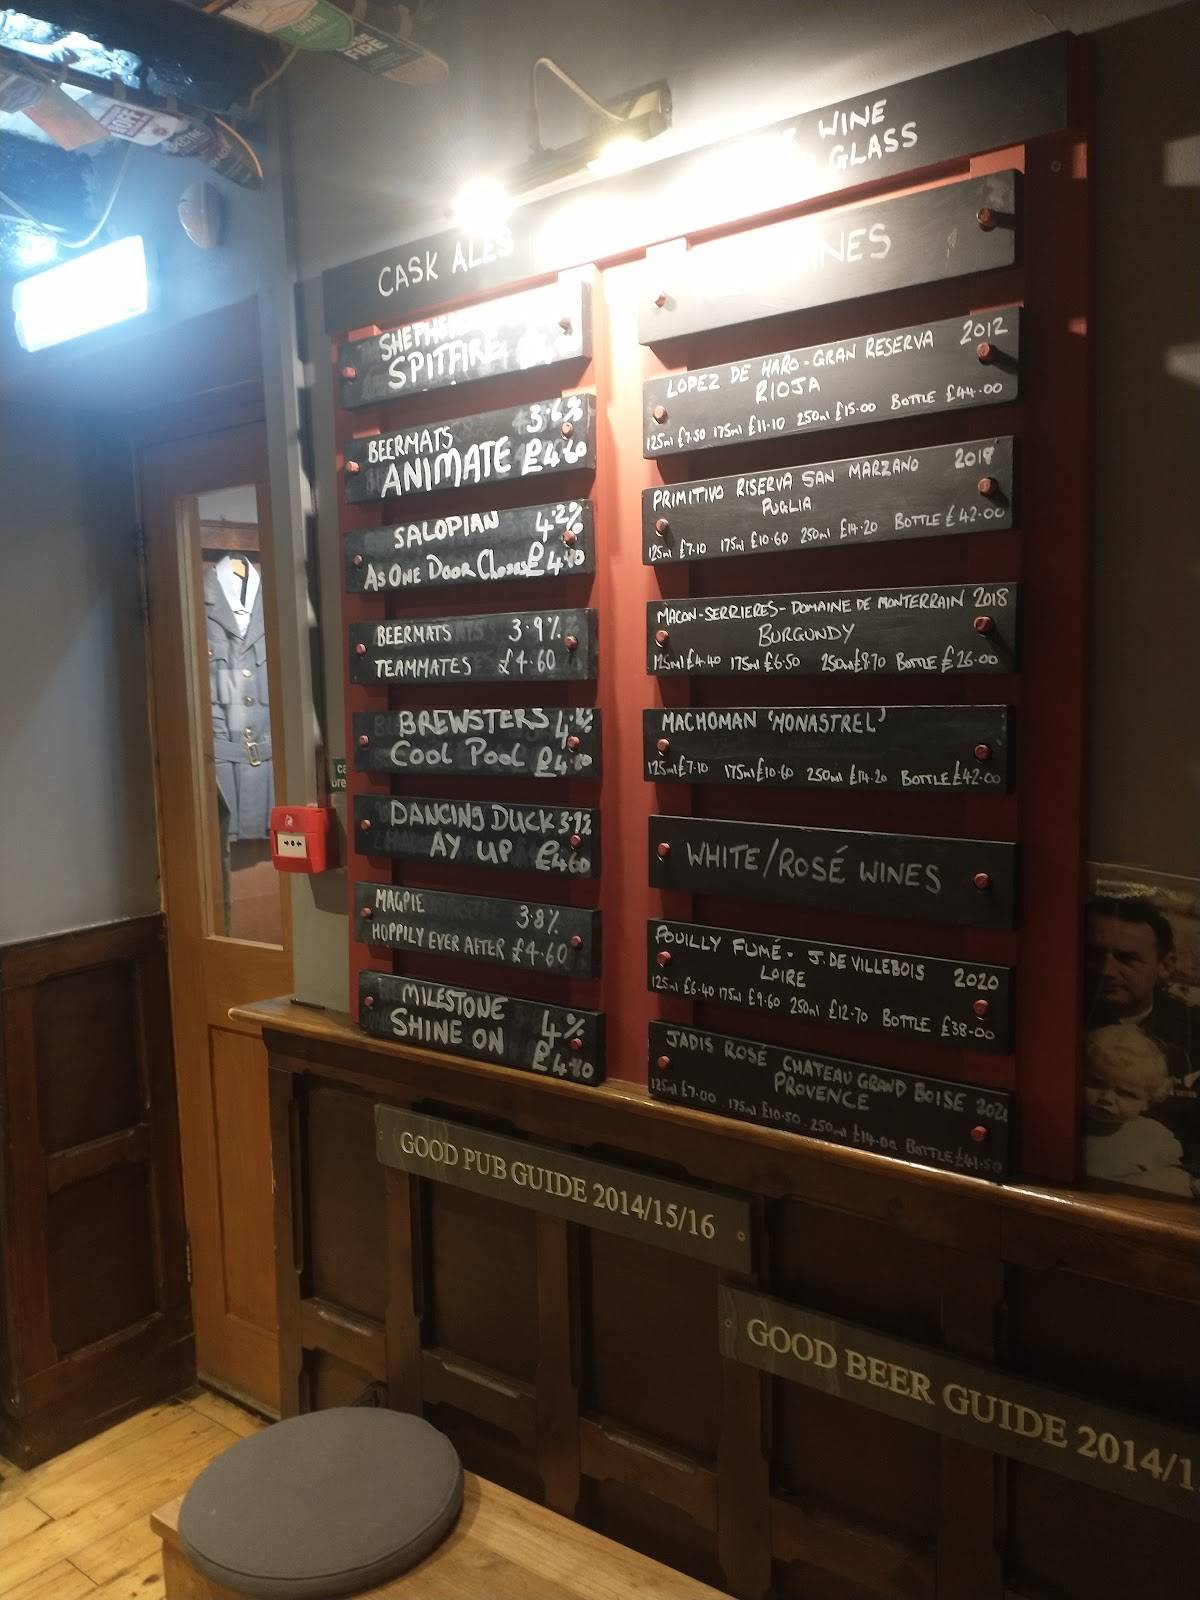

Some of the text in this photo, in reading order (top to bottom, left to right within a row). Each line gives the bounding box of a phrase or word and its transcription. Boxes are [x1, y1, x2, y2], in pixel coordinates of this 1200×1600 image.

[819, 100, 888, 138] WINE
[829, 121, 918, 168] GLASS
[378, 226, 514, 297] CASK ALES
[388, 333, 505, 389] SPITFIRE
[666, 374, 720, 398] LOPEZ
[730, 364, 752, 384] DE
[865, 330, 934, 358] RESERVA
[960, 317, 1008, 345] 2012
[755, 376, 821, 404] RIOJA
[677, 426, 706, 448] £7.50
[749, 415, 785, 436] £11.10
[835, 401, 876, 421] £15.00
[946, 383, 1003, 402] £44.00
[368, 426, 453, 463] BEERMATS
[381, 436, 512, 498] ANIMATE
[653, 485, 724, 511] PRIMITIVO
[736, 472, 793, 497] RISERVA
[802, 469, 835, 487] SAN
[849, 456, 919, 480] MARZANO
[762, 497, 812, 516] PUGLIA
[394, 511, 500, 549] SALOPIAN
[680, 538, 707, 559] £7.10
[751, 531, 789, 549] £10.60
[840, 518, 878, 539] £14.20
[946, 505, 1005, 527] £42.00
[791, 599, 851, 614] DOMAINE
[857, 597, 872, 610] DE
[878, 590, 965, 609] MONTERRAIN
[973, 587, 1009, 608] 2018
[377, 616, 562, 647] BEERMATS 3.9%
[759, 623, 855, 647] BURGUNDY
[375, 648, 555, 678] TEAMMATES £4.60
[687, 649, 721, 670] £4.40
[764, 651, 800, 672] £6.50
[941, 645, 998, 673] £26.00
[399, 708, 549, 737] BREWSTERS
[662, 710, 757, 733] MACHOMAN
[678, 755, 708, 777] £7.10
[757, 758, 793, 782] £10.60
[850, 764, 887, 785] £14.20
[491, 803, 554, 834] DUCK
[430, 831, 461, 860] AY
[476, 838, 513, 864] UP
[859, 861, 942, 894] WINES
[375, 889, 560, 936] MAGPIE 3.8%
[372, 923, 568, 967] HOPPILY EVER AFTER £4.60
[655, 925, 721, 953] POUILLY
[851, 956, 925, 981] VILLEBOIS
[954, 967, 999, 990] 2020
[760, 964, 806, 988] LOIRE
[402, 984, 585, 1048] MILESTONE 4%
[684, 976, 714, 998] £6.40
[749, 987, 780, 1009] £9.60
[829, 999, 868, 1024] £12.70
[390, 1008, 462, 1044] SHINE
[472, 1027, 504, 1055] ON
[666, 1030, 714, 1053] JADIS
[782, 1055, 851, 1086] CHATEAU
[914, 1082, 966, 1112] BOISE
[774, 1071, 870, 1111] PROVENCE
[400, 1131, 716, 1240] GOOD PUB GUIDE 2014/15/16
[747, 1318, 1200, 1493] GOOD BEER GUIDE 2014/1
